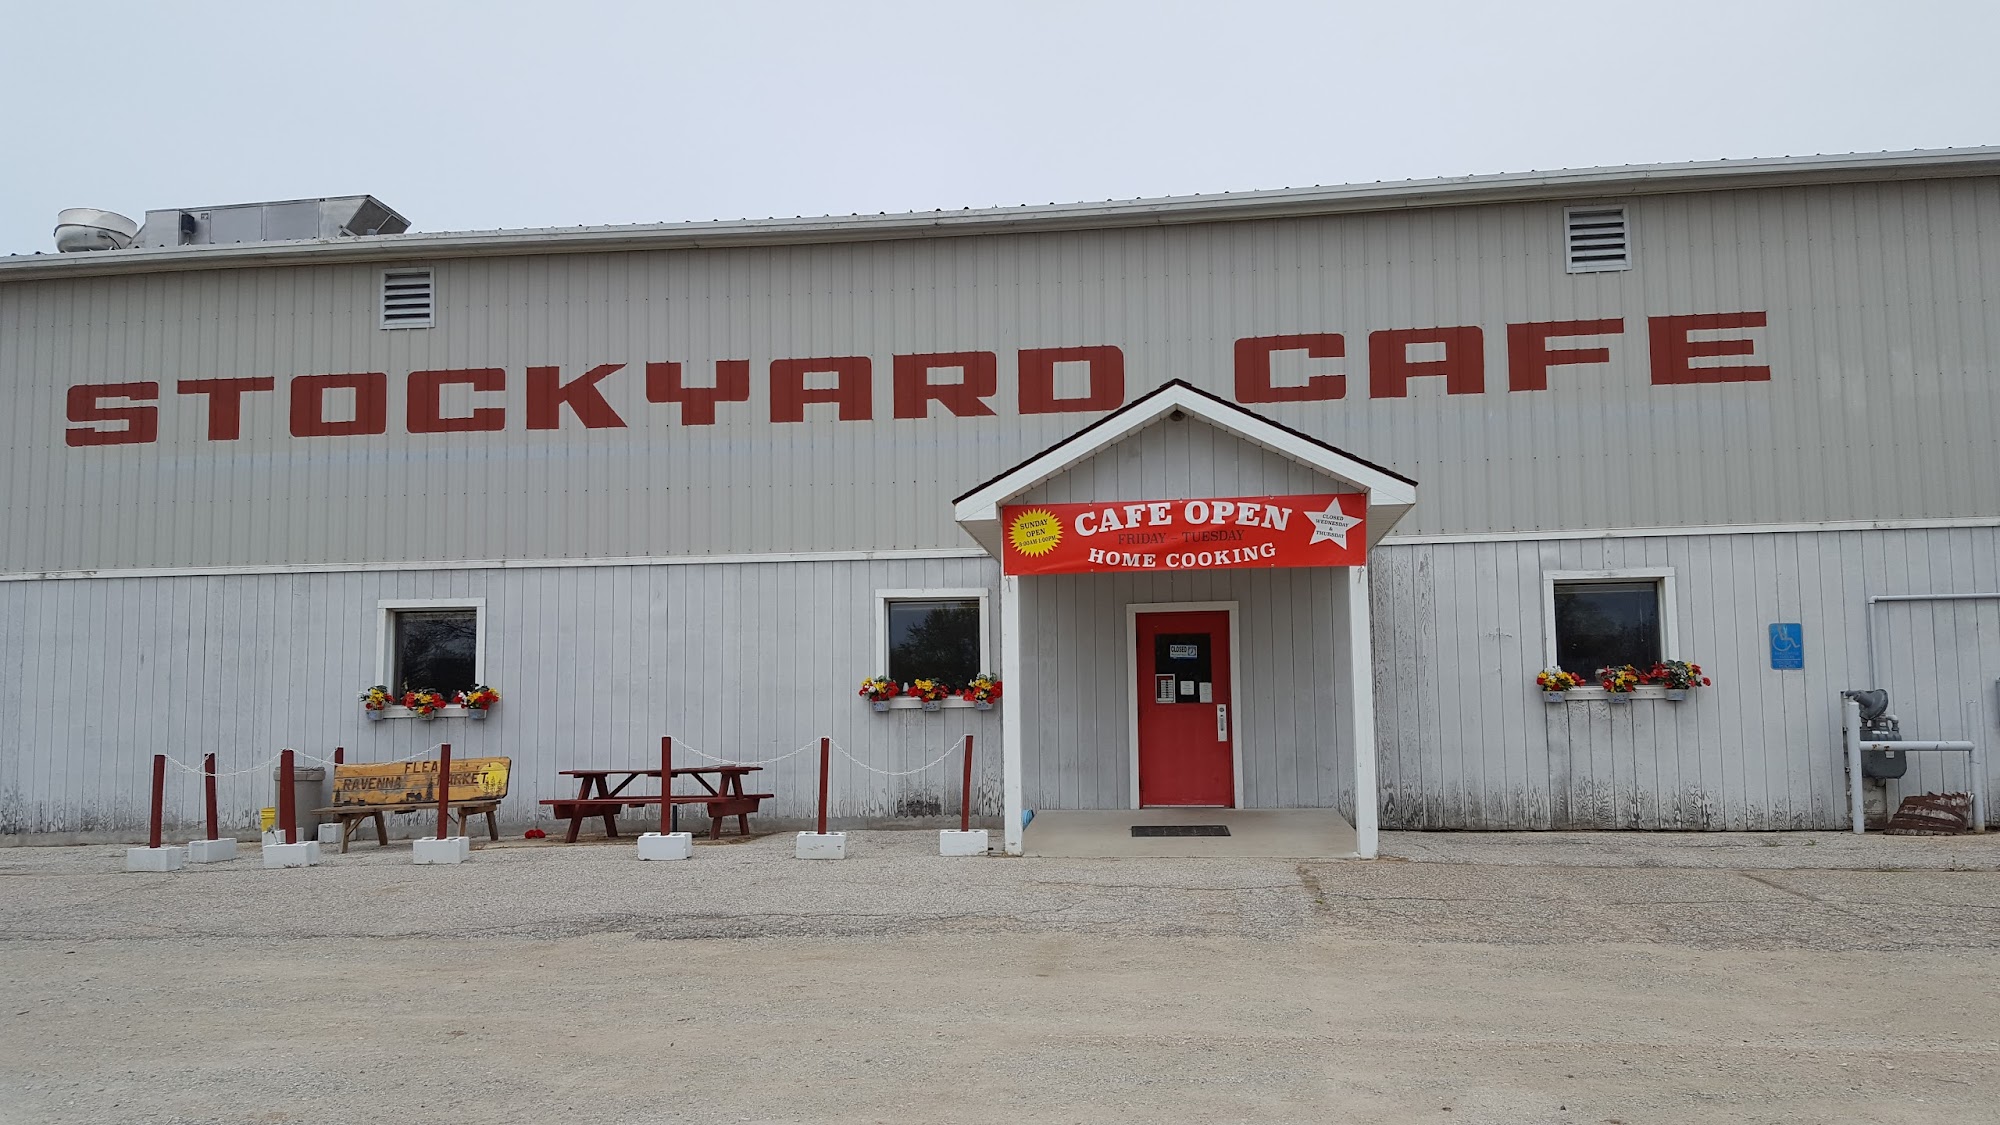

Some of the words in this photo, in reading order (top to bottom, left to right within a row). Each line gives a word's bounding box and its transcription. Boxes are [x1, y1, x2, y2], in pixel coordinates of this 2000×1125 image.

[66, 345, 1124, 448] STOCKYARD
[1234, 311, 1771, 403] CAFE
[1020, 519, 1048, 530] SUNDAY
[1075, 502, 1172, 536] CAFE
[1184, 501, 1292, 531] OPEN
[1316, 519, 1349, 527] WEDNESDAY
[1026, 528, 1046, 537] OPEN
[1118, 532, 1167, 545] FRIDAY
[1182, 530, 1245, 543] TUESDAY
[1316, 531, 1345, 539] THURSDAY
[1088, 548, 1156, 567] HOME
[1166, 542, 1276, 568] COOKING
[1171, 645, 1187, 653] CLOSED
[404, 761, 438, 774] FLEA
[343, 776, 401, 790] RAVENNA
